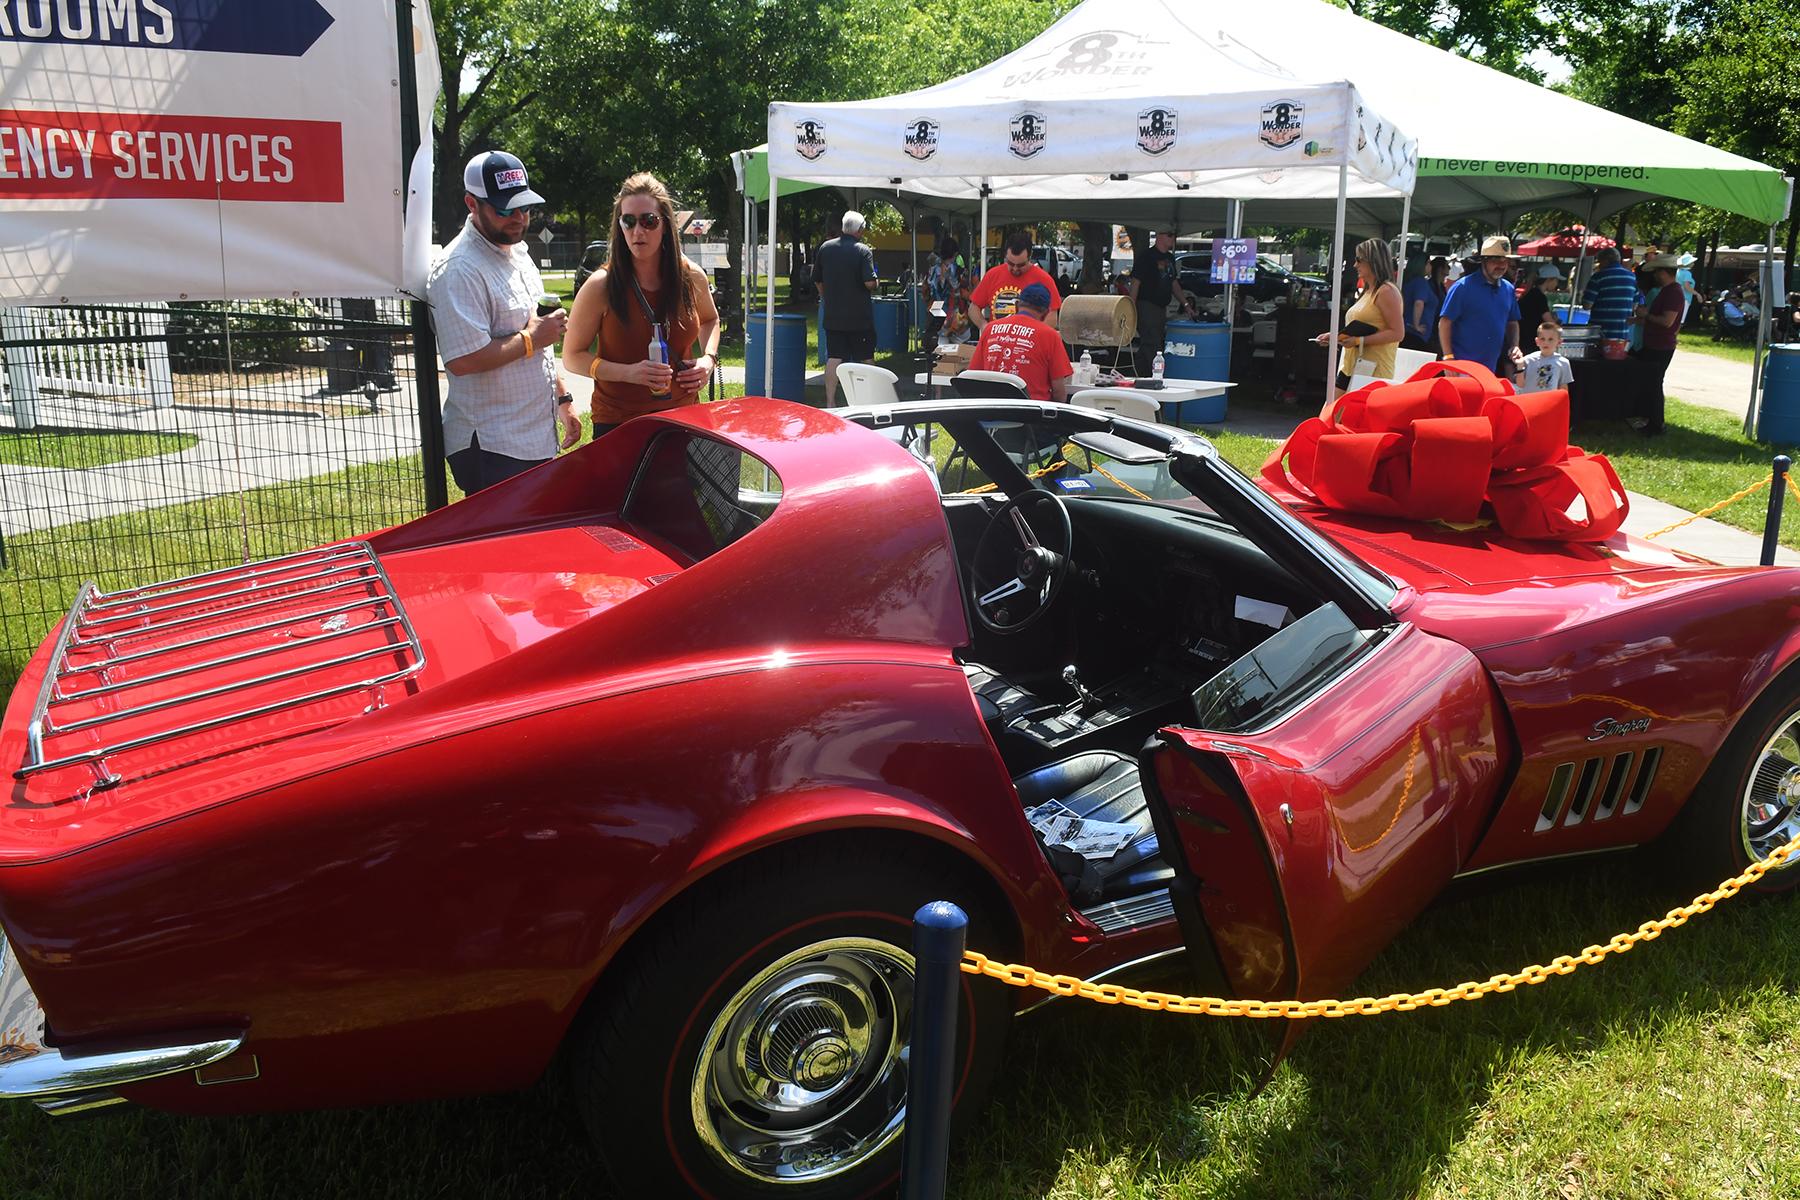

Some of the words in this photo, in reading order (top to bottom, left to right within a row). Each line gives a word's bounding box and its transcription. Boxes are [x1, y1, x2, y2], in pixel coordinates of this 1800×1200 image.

[1139, 126, 1175, 137] WONDER
[1262, 120, 1301, 131] WONDER
[1011, 131, 1045, 141] WONDER
[111, 130, 294, 183] SERVICES
[1436, 159, 1488, 171] never
[1495, 161, 1539, 173] even
[991, 323, 1012, 335] EVENT
[1011, 324, 1036, 338] STAFF
[1587, 717, 1652, 741] Stingray
